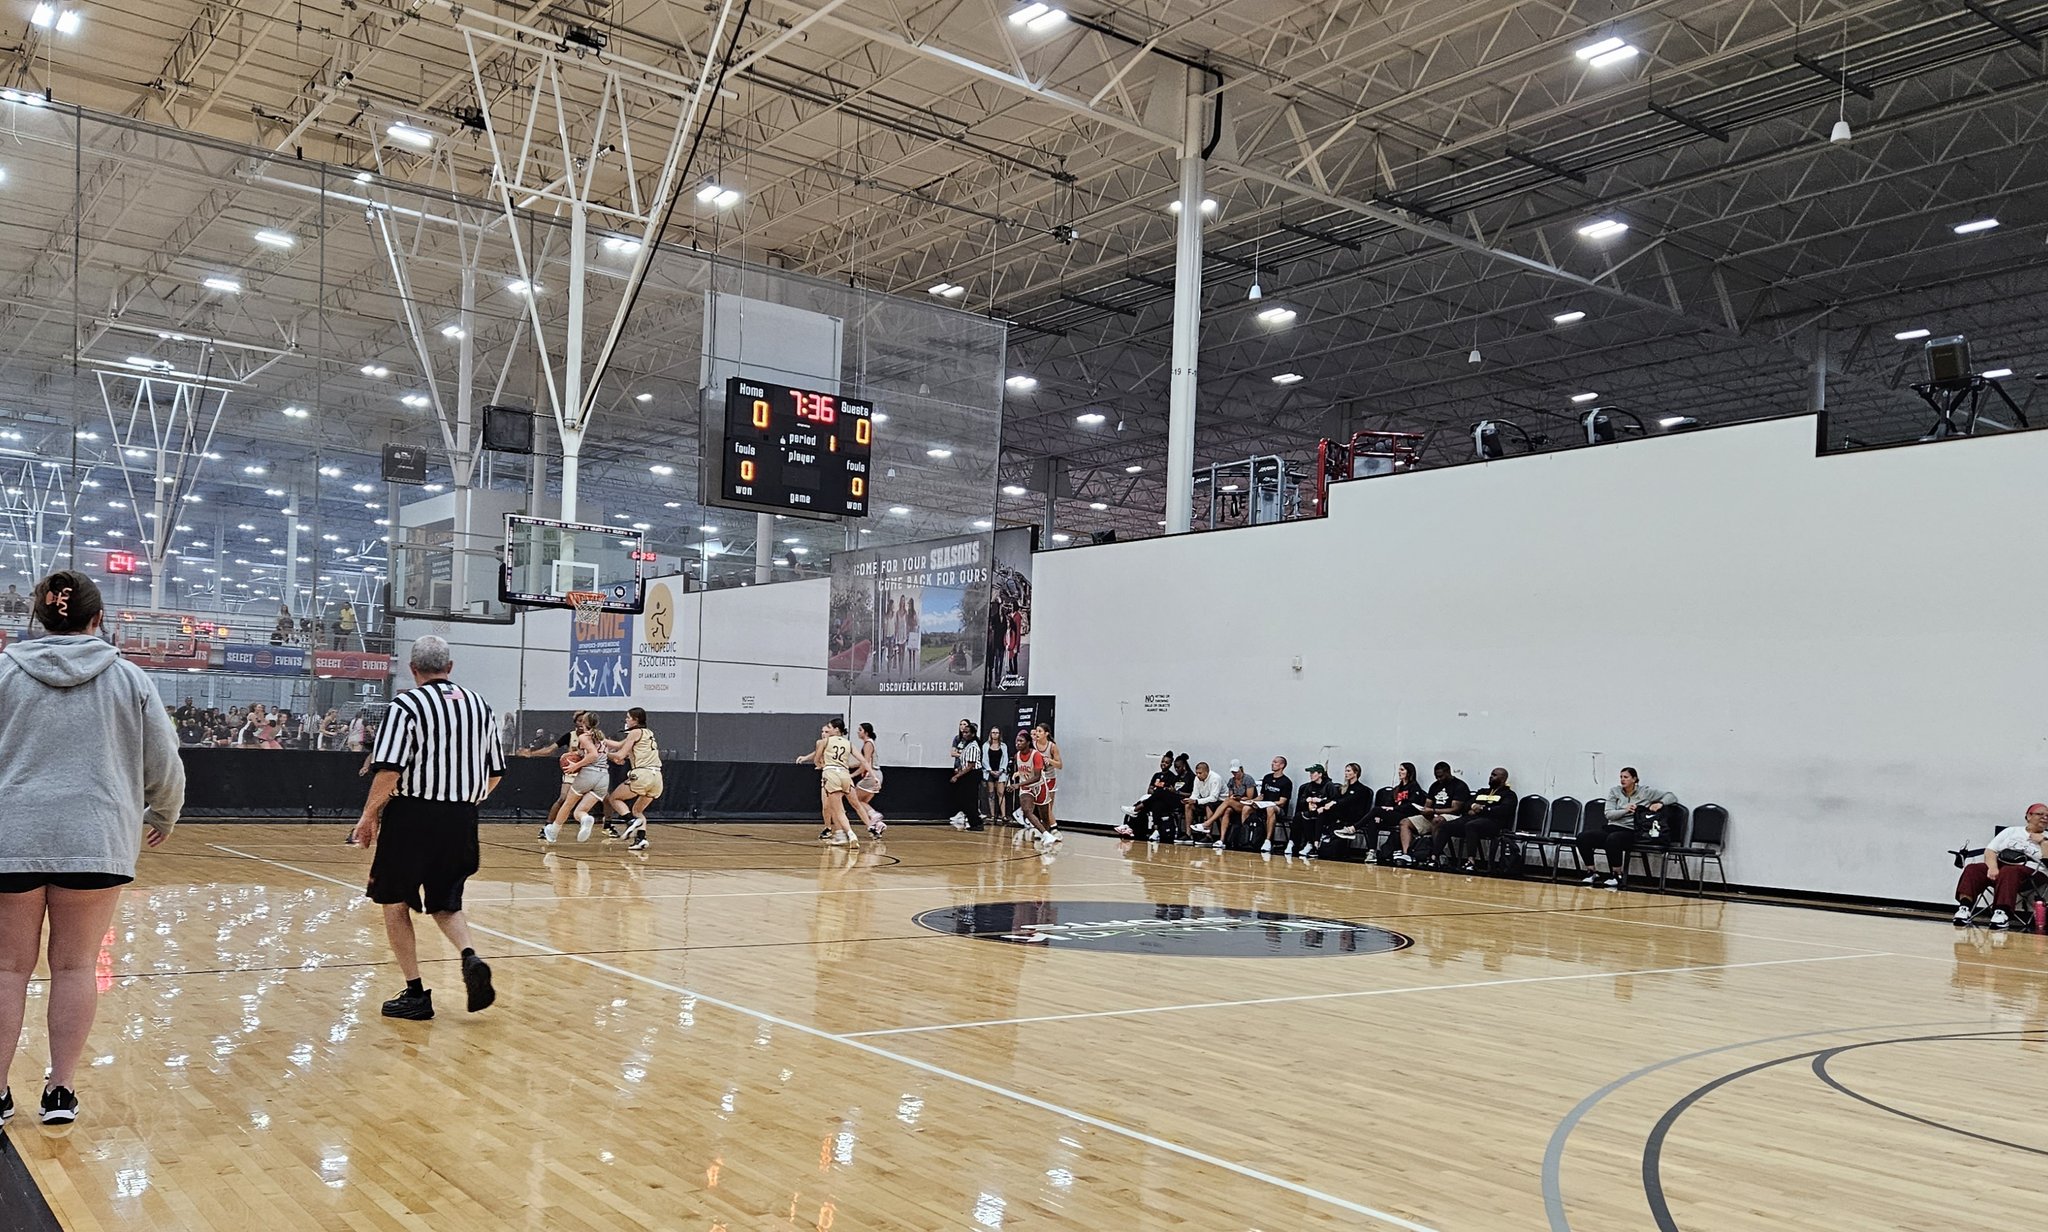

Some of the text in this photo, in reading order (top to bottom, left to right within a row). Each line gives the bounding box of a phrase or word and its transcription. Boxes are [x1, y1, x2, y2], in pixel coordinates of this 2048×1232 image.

[740, 383, 764, 398] Home
[790, 390, 834, 423] 7:36
[841, 402, 869, 416] Guests
[753, 400, 768, 428] 0
[856, 419, 870, 445] 0
[789, 433, 816, 446] period
[829, 434, 836, 452] 1
[735, 442, 756, 456] fouls
[788, 450, 816, 464] player
[740, 460, 754, 481] 0
[846, 460, 865, 473] fouls
[735, 485, 752, 496] won
[851, 477, 863, 496] 0
[789, 493, 811, 504] game
[846, 501, 862, 511] won
[109, 554, 133, 571] 24
[881, 560, 898, 573] FOR
[902, 555, 927, 571] YOUR
[930, 540, 980, 570] SEASONS
[878, 568, 988, 592] COME BACK FOR OURS
[639, 642, 677, 654] ORTHOPEDIC
[226, 652, 303, 667] SELECT EVENTS
[315, 657, 388, 671] SELECT EVENTS
[638, 656, 676, 667] ASSOCIATES
[879, 681, 964, 692] DISCOVERLANCASTER.COM
[997, 675, 1025, 691] Lancaster
[1145, 694, 1155, 703] NO
[832, 745, 846, 763] 32
